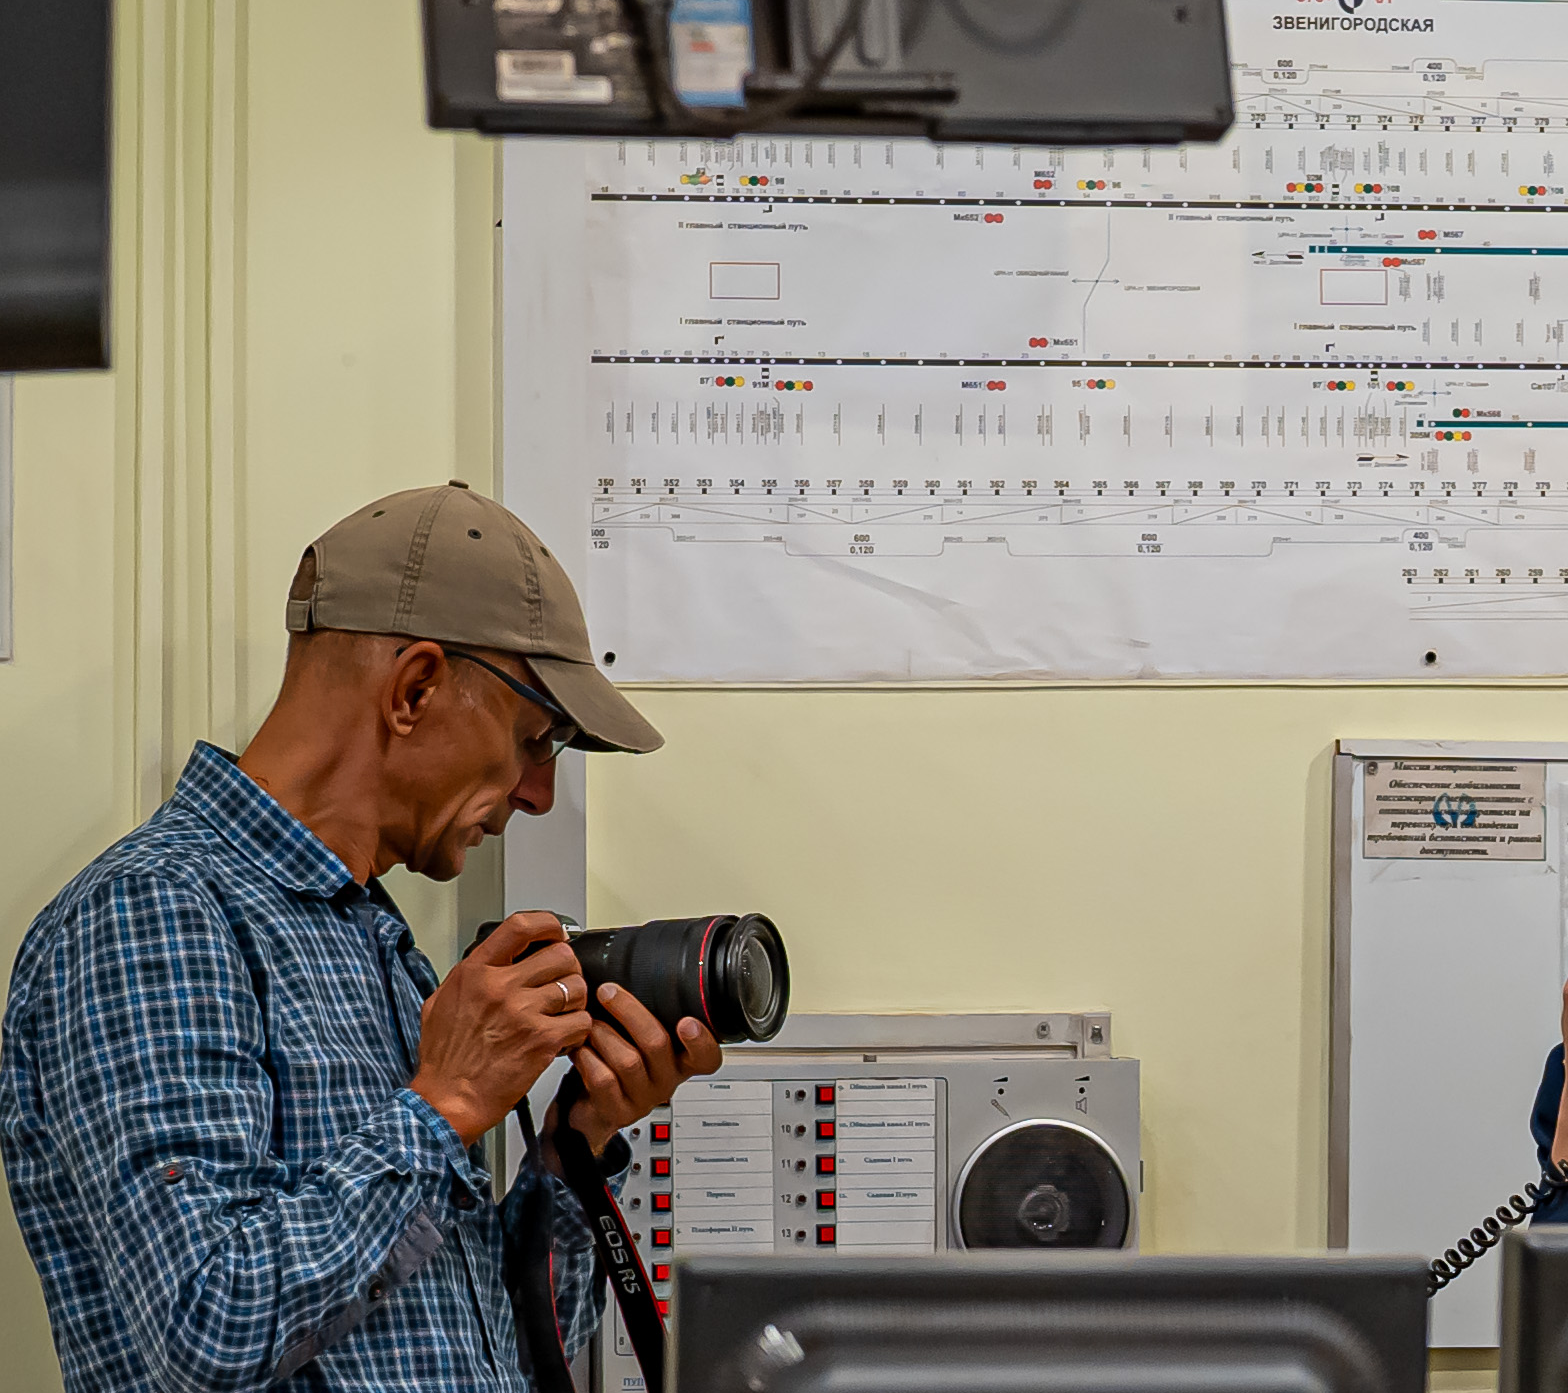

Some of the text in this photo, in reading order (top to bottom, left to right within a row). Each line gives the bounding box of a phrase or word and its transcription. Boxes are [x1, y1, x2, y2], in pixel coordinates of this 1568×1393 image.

[1273, 16, 1433, 34] ЗВЕНИГОРОДСКАЯ
[664, 479, 679, 487] 352
[697, 479, 712, 487] 353
[730, 479, 744, 487] 354
[827, 480, 842, 488] 357
[859, 480, 874, 488] 358
[893, 480, 908, 488] 359
[925, 480, 940, 488] 360
[957, 480, 972, 488] 361
[850, 546, 874, 554] 0,120
[1408, 542, 1433, 551] 0,120
[1391, 760, 1430, 770] Миссия
[1389, 780, 1520, 789] Обеспечение мобильности
[1367, 833, 1426, 843] требований
[1429, 833, 1497, 842] безопасности
[1507, 835, 1542, 845] равной
[1420, 847, 1488, 857] доступности.
[785, 1090, 791, 1098] 9
[781, 1125, 791, 1133] 10
[782, 1159, 790, 1168] 11
[781, 1194, 791, 1203] 12
[782, 1229, 791, 1237] 13
[600, 1215, 640, 1293] EOS R5
